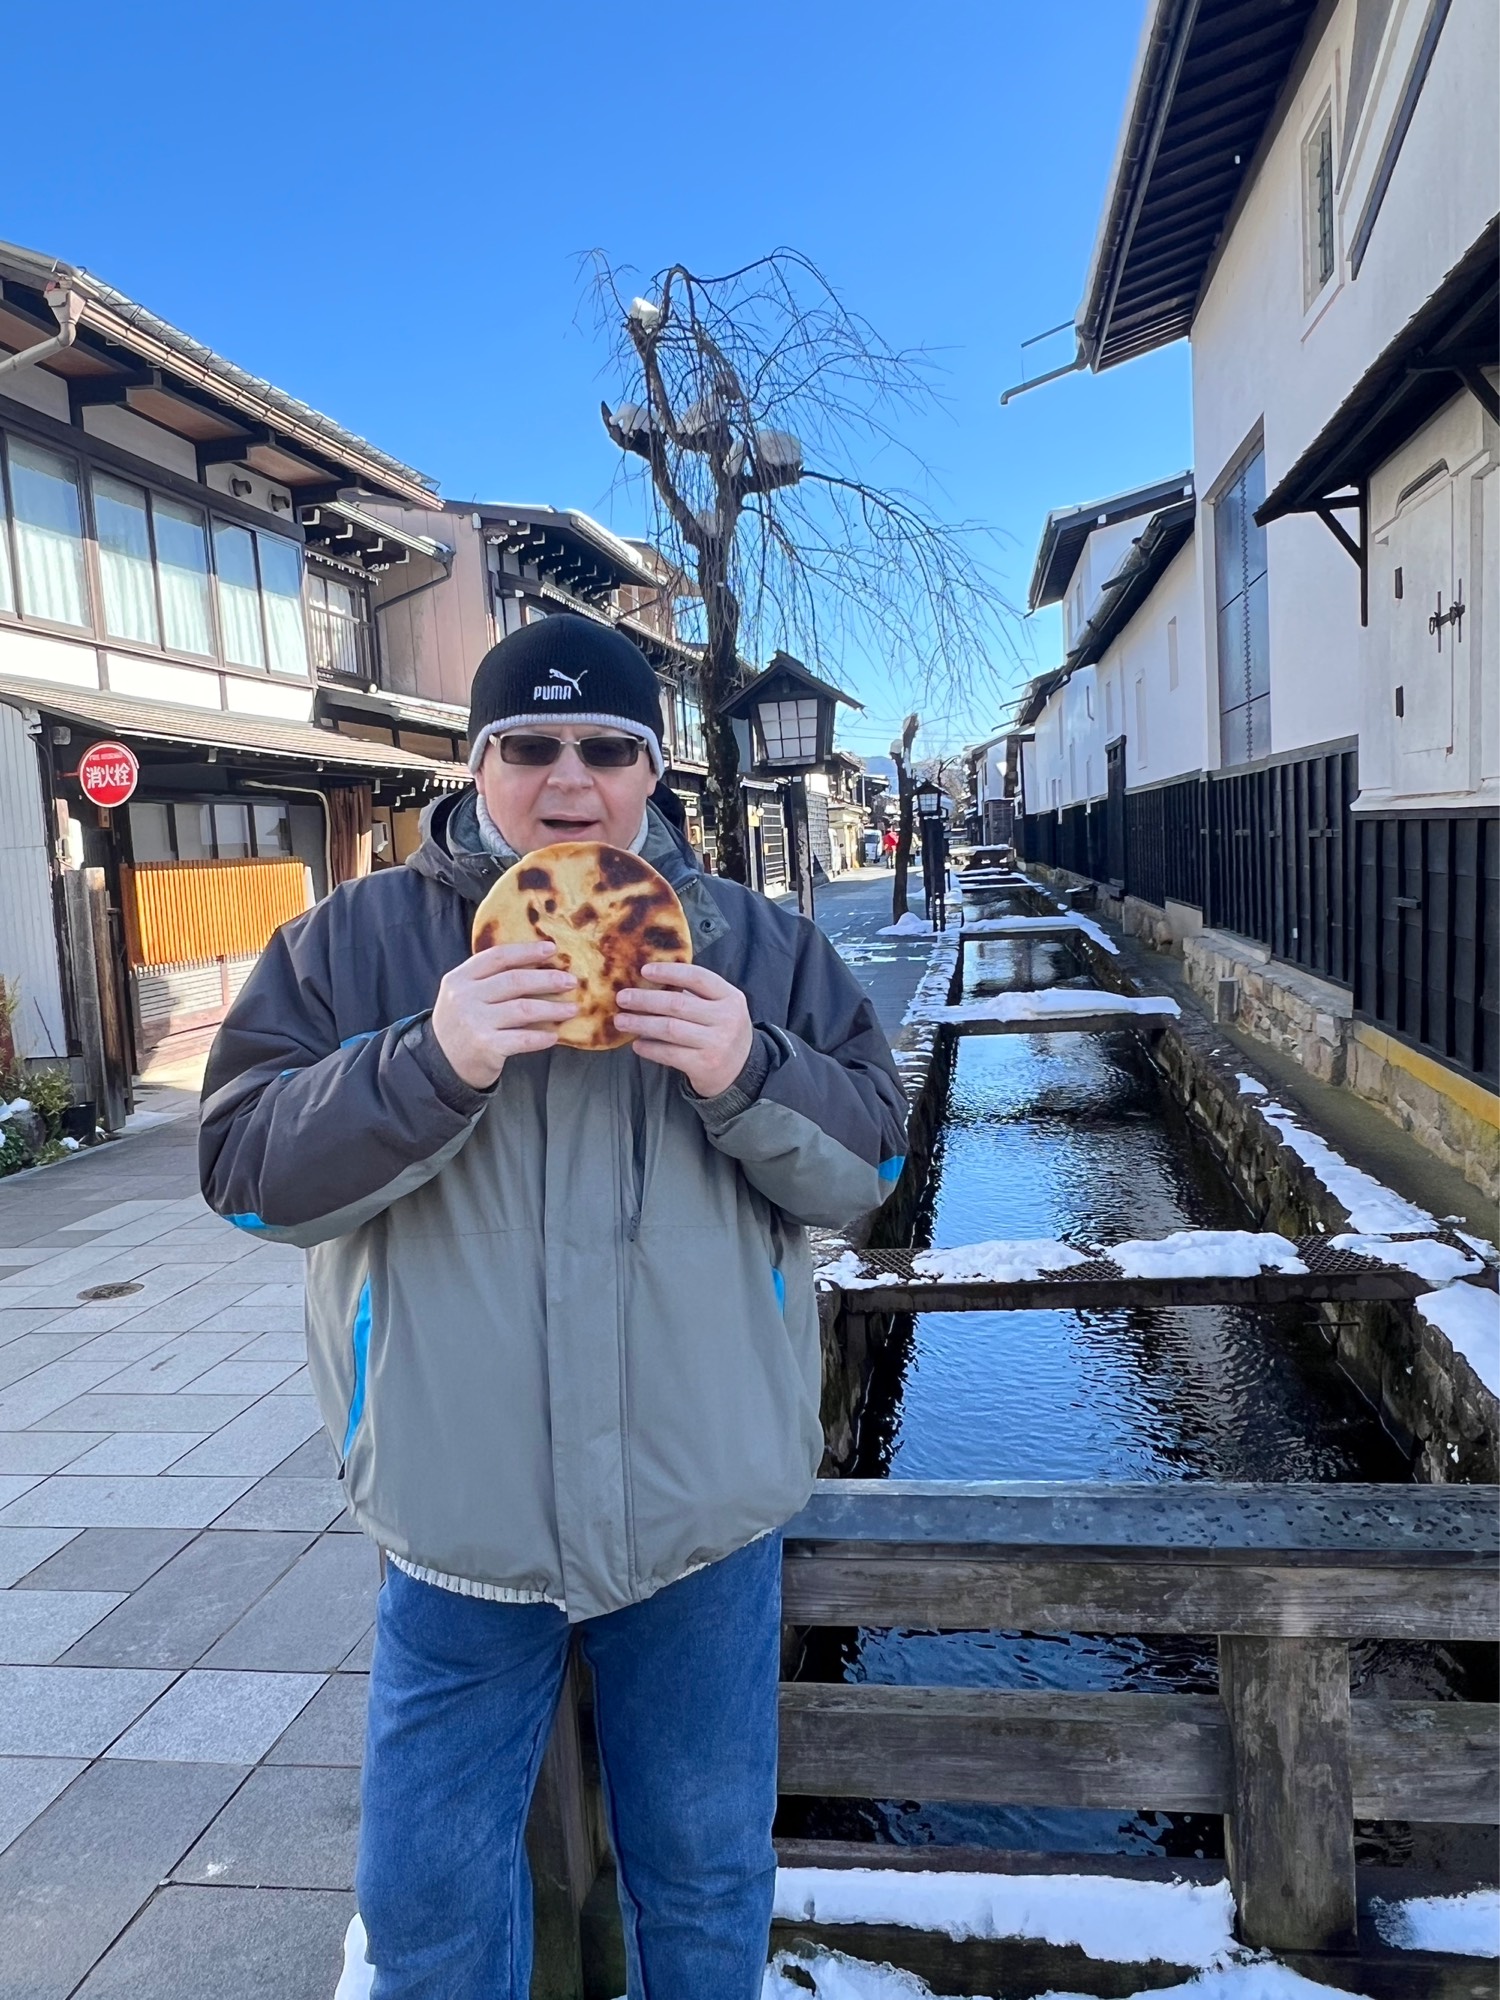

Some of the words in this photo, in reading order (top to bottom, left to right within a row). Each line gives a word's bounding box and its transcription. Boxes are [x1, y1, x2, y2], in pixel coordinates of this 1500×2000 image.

[533, 685, 572, 701] PUMA
[85, 763, 131, 789] 消火栓
